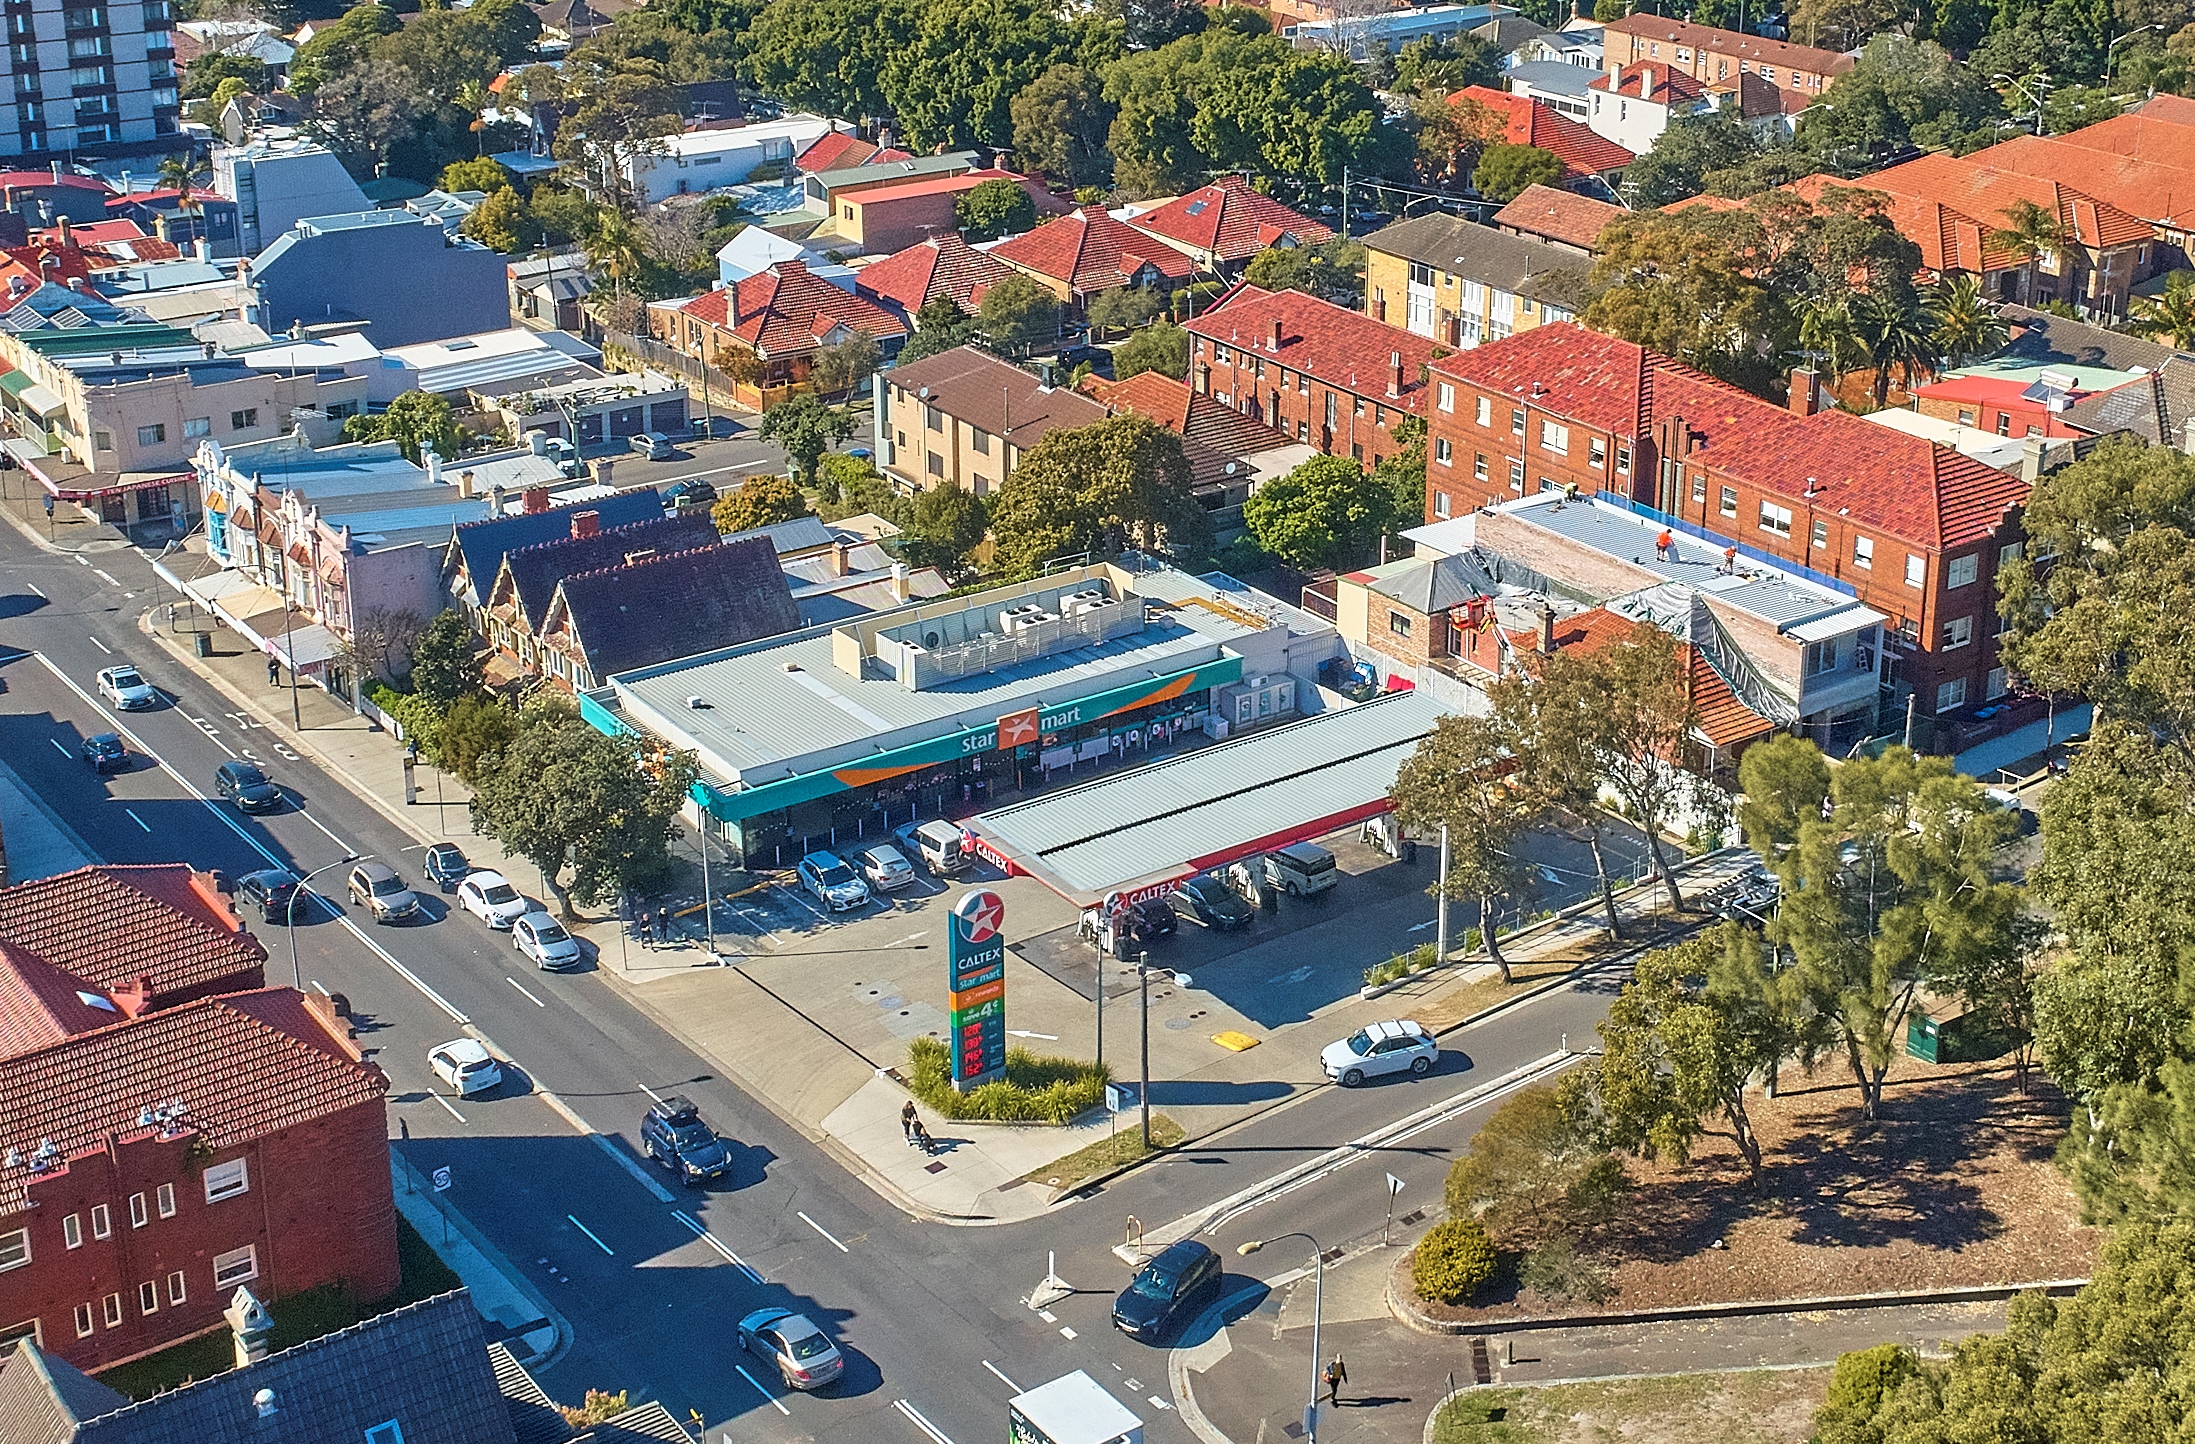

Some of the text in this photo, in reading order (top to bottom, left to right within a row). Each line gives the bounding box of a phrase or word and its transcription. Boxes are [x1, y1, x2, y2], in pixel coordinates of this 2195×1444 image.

[122, 480, 160, 492] JAPANESE
[161, 474, 189, 485] CUISINE
[962, 706, 1081, 752] star mart
[976, 843, 1007, 873] CALTEX
[1129, 880, 1176, 905] CALTEX
[958, 947, 1001, 970] CALTEX
[960, 969, 1000, 989] star mart
